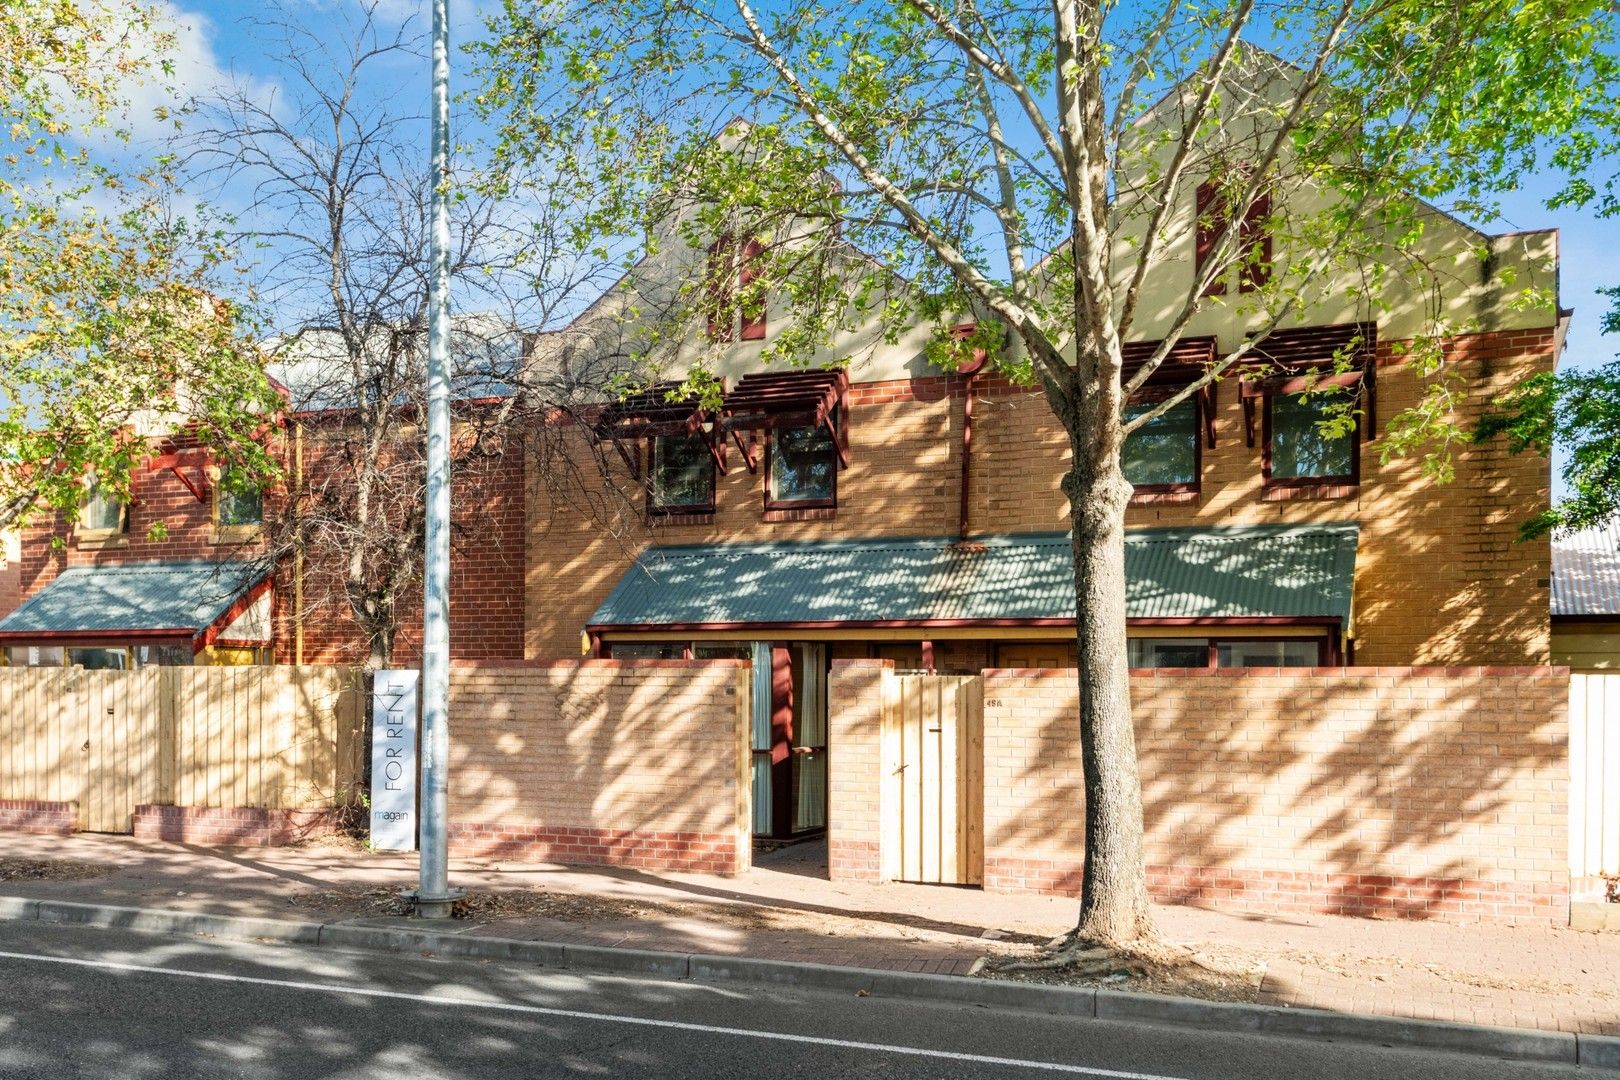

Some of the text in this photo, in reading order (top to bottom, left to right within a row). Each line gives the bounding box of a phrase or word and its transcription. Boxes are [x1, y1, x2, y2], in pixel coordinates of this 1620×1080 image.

[385, 681, 404, 791] FOR RENT
[375, 811, 408, 822] magain
